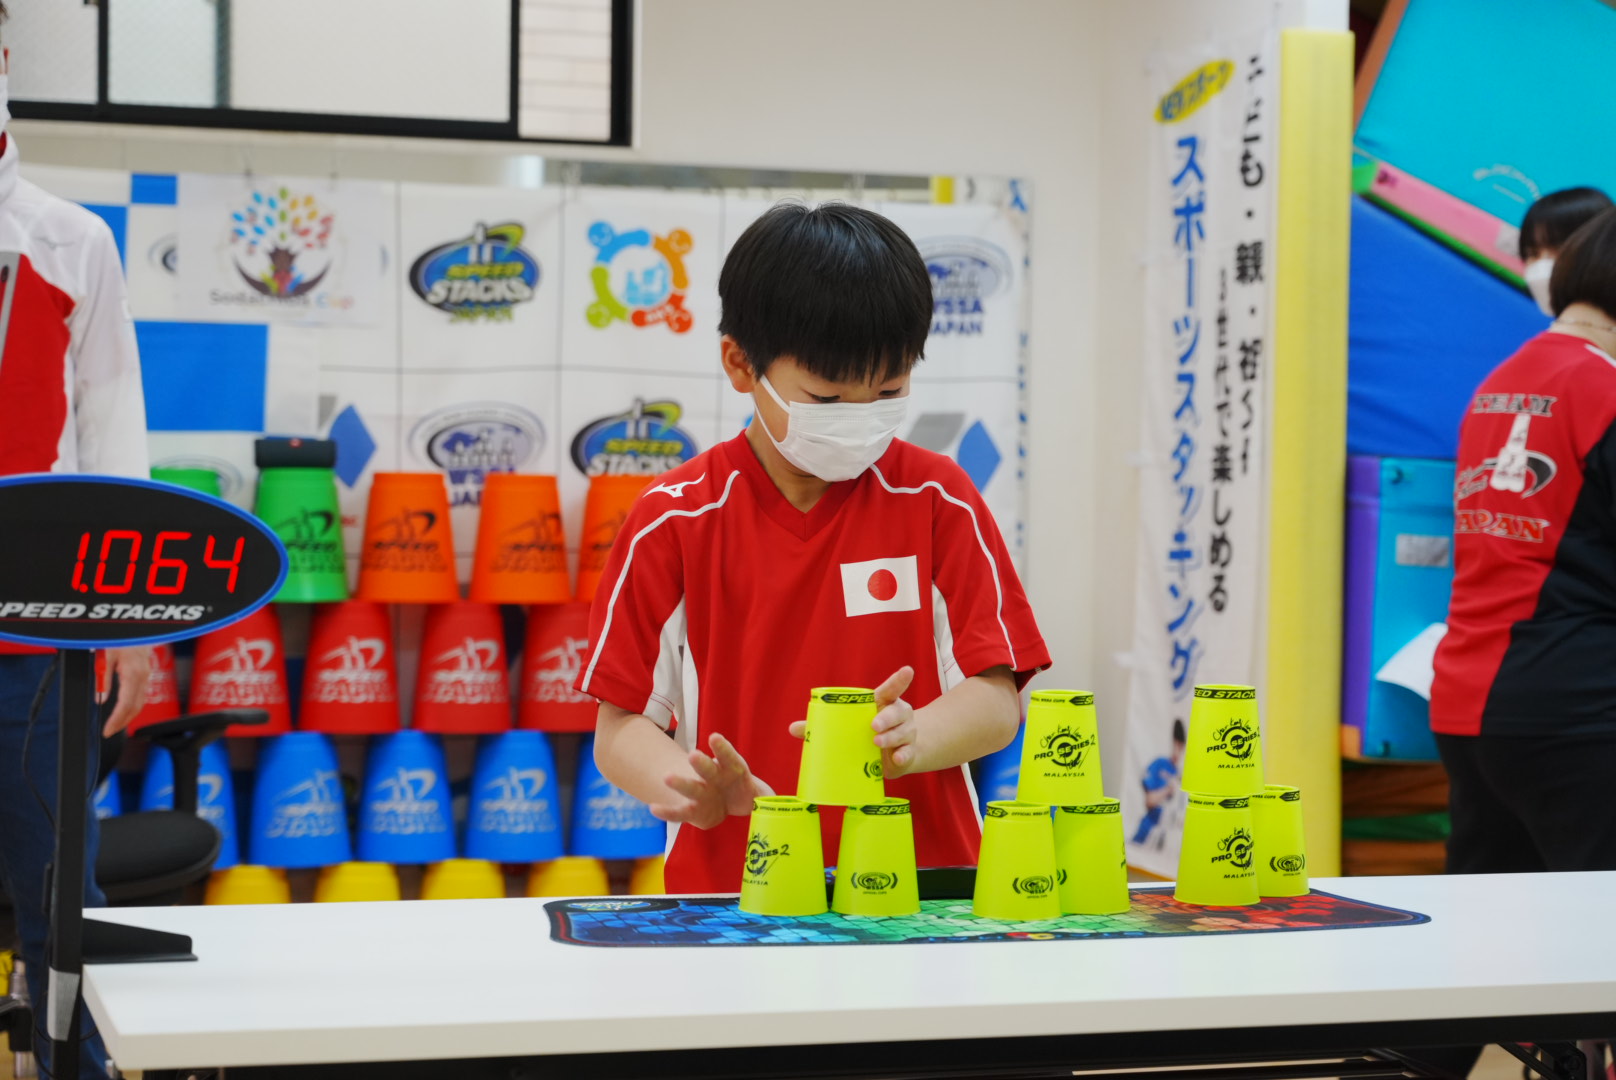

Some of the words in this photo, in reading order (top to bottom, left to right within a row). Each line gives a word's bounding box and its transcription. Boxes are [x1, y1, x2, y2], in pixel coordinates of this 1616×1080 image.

[447, 262, 525, 277] SPEED
[426, 279, 534, 303] STACKS
[933, 298, 983, 314] SSA
[931, 321, 982, 334] APAN
[1472, 394, 1557, 417] TEAM
[605, 438, 683, 453] SPEED
[1455, 509, 1550, 543] APAN
[71, 530, 245, 594] 1.064
[0, 603, 86, 618] PEED
[88, 604, 205, 620] STACKS
[1034, 751, 1054, 760] PRO
[1206, 743, 1227, 753] PRO
[780, 844, 790, 856] 2
[1211, 852, 1232, 863] PRO
